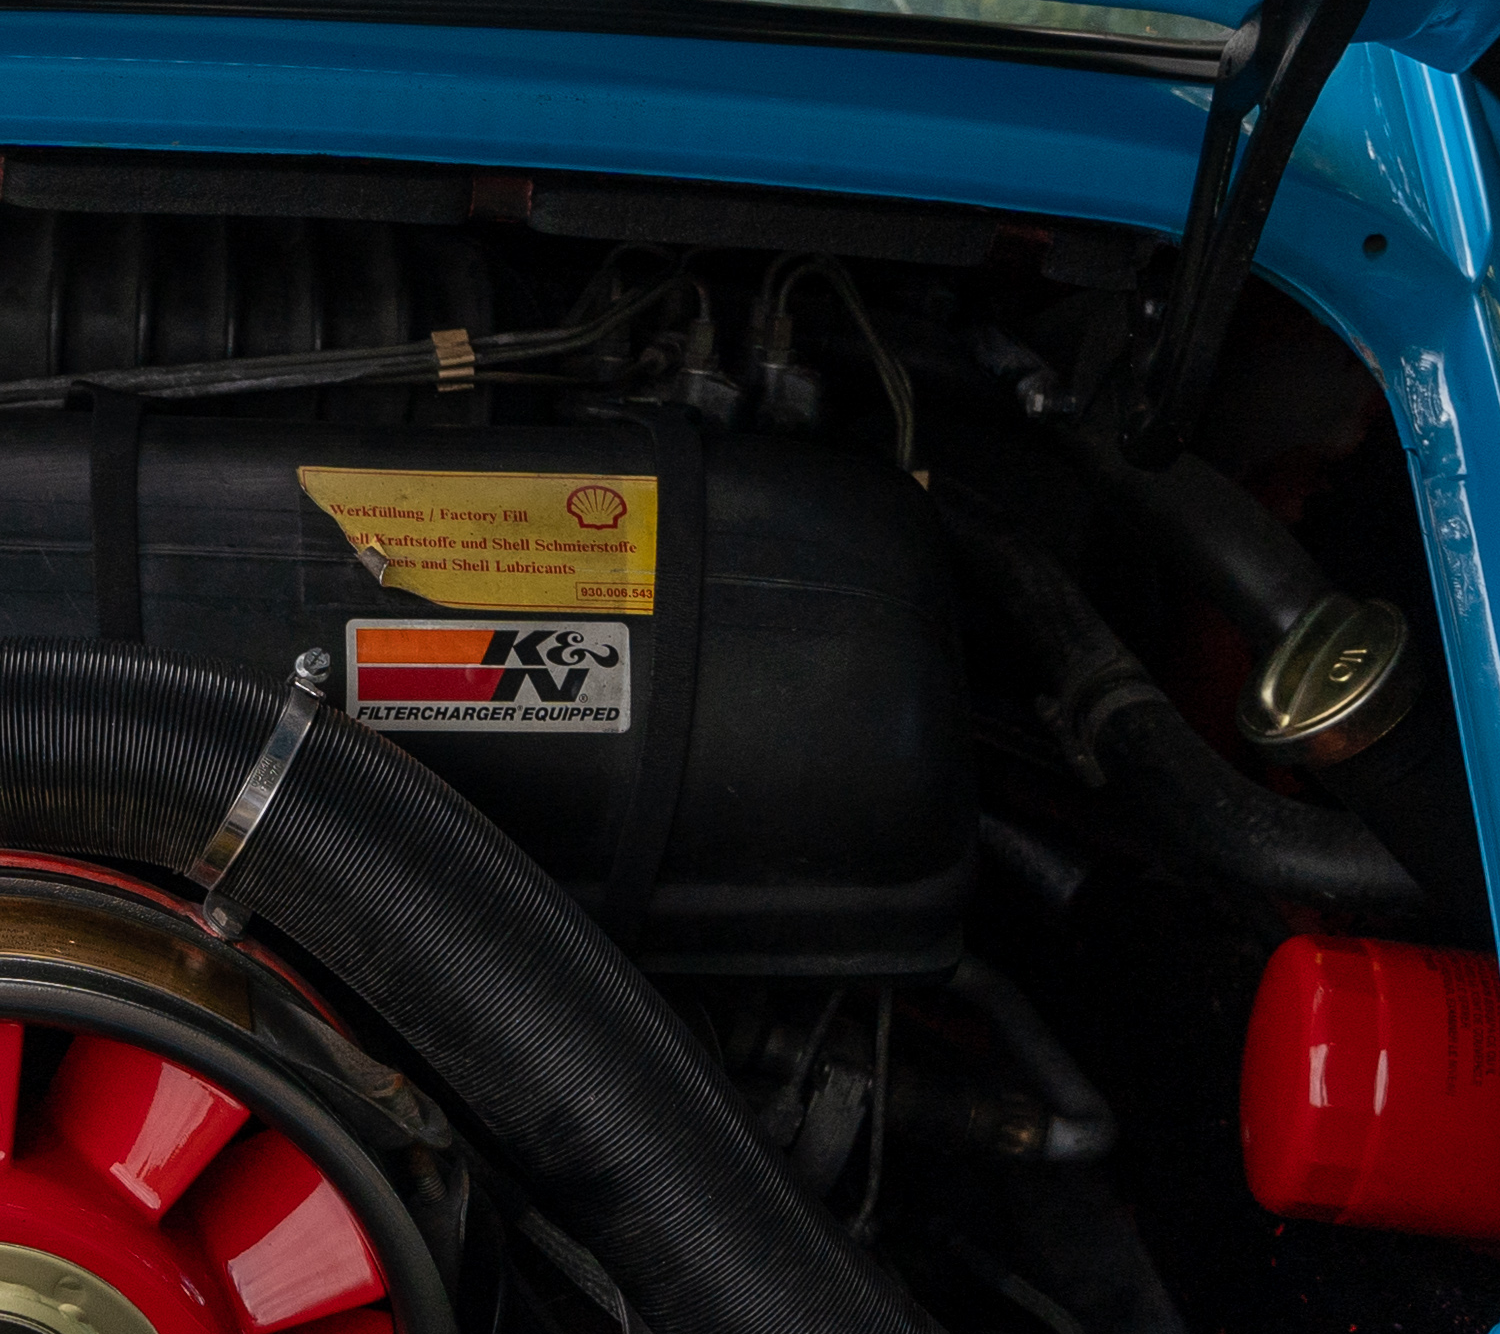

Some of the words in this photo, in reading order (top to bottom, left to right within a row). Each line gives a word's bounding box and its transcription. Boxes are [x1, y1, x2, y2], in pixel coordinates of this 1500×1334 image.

[329, 503, 425, 522] Werkfüllung
[440, 508, 497, 525] Factory
[502, 509, 529, 524] Fill
[375, 534, 457, 549] Kraftstoffe
[461, 537, 488, 551] und
[492, 537, 530, 552] Shell
[534, 539, 637, 555] Schmierstoffe
[421, 557, 447, 570] and
[451, 557, 490, 572] Shell
[495, 559, 576, 576] Lubricants
[580, 585, 653, 600] 930.006.543
[521, 706, 620, 722] EQUIPPED
